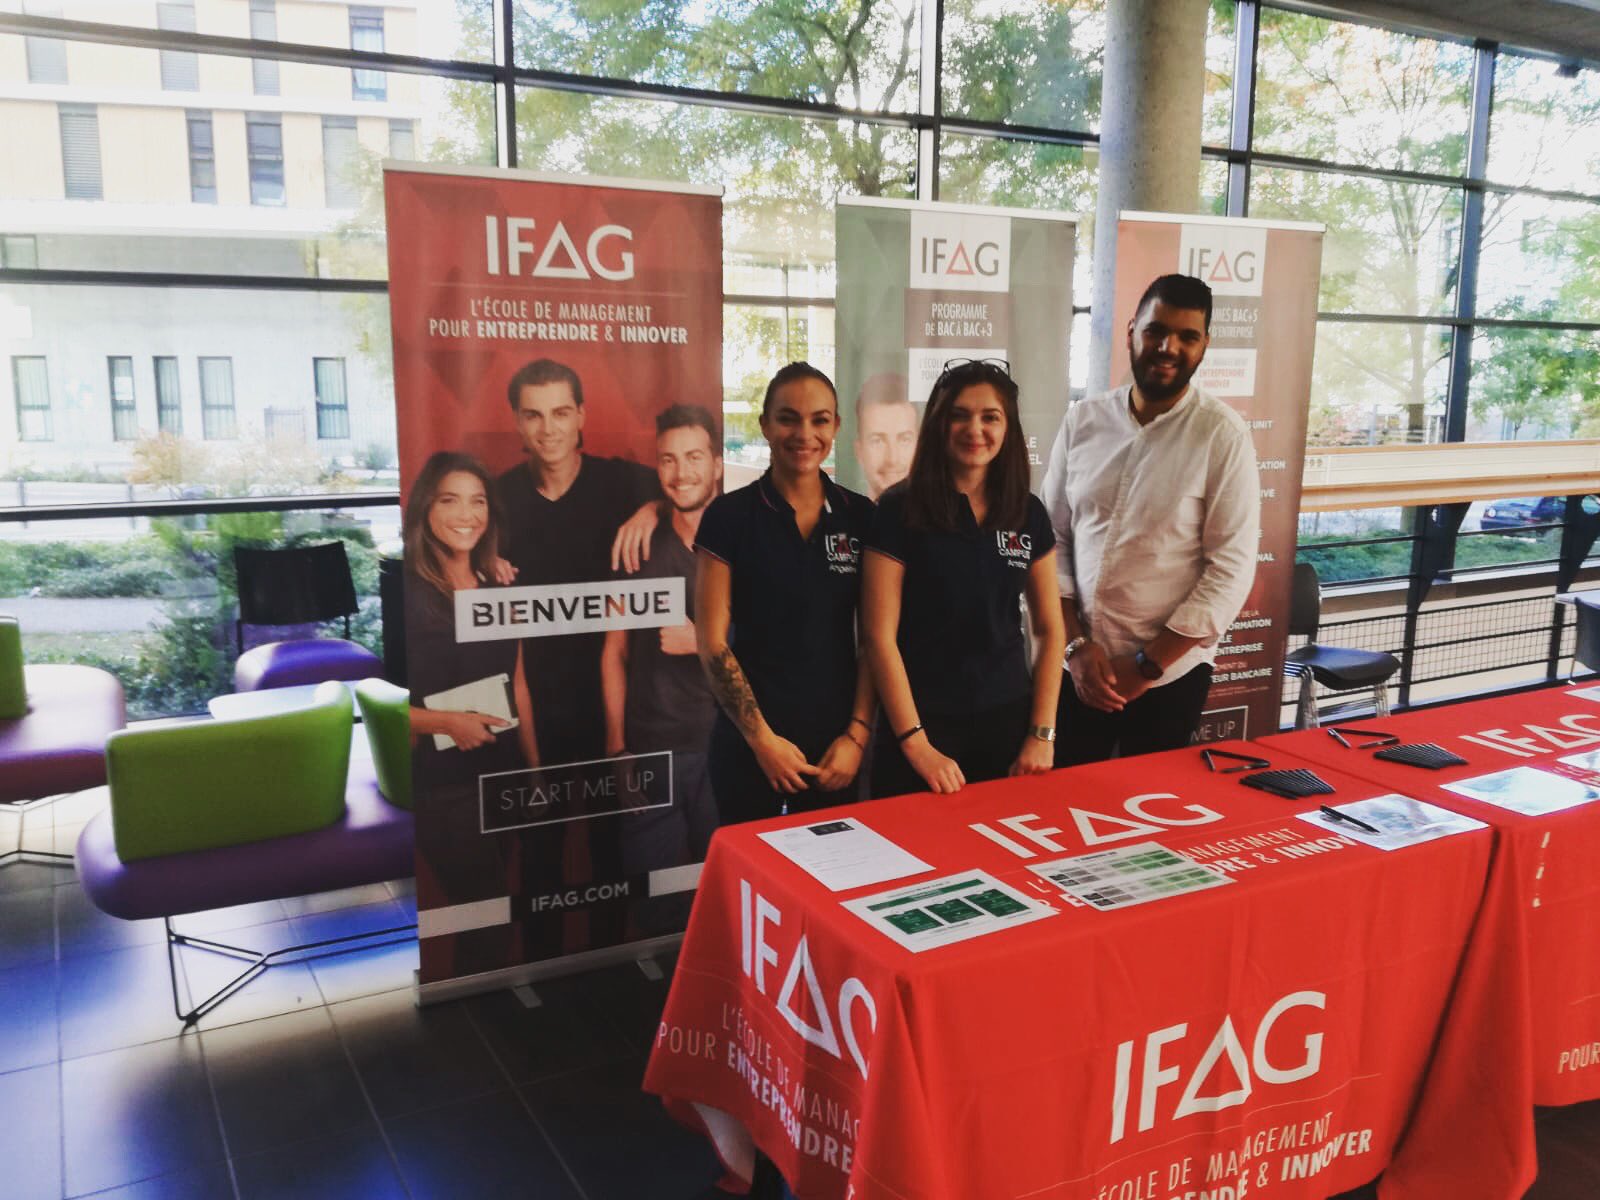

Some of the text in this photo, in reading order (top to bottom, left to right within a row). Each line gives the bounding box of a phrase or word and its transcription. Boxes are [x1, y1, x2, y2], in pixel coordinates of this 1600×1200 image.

[486, 215, 635, 281] IFAG
[921, 237, 999, 276] IFAG
[470, 296, 652, 323] L'ÉCOLE DE MANAGEMENT
[931, 303, 990, 320] PROGRAMME
[429, 318, 688, 344] POUR ENTREPRENDRE & INNOVER
[925, 322, 936, 336] DE
[937, 321, 955, 337] BAC
[963, 321, 993, 337] BAC+3
[1256, 461, 1286, 470] CATION
[472, 591, 671, 628] BIENVENUE
[1227, 619, 1272, 631] ORMATION
[1217, 720, 1236, 739] UP
[500, 770, 655, 811] START ME UP
[968, 793, 1225, 859] IFAG
[1177, 829, 1305, 860] ANAGEMENT
[1252, 852, 1280, 864] &
[1274, 835, 1358, 859] INNOV
[531, 881, 630, 913] IFAG.COM
[656, 1021, 717, 1060] POUR
[1110, 991, 1326, 1145] IFAG
[1168, 1157, 1193, 1191] DE
[1256, 1161, 1269, 1188] &
[1281, 1129, 1373, 1182] INNOVER
